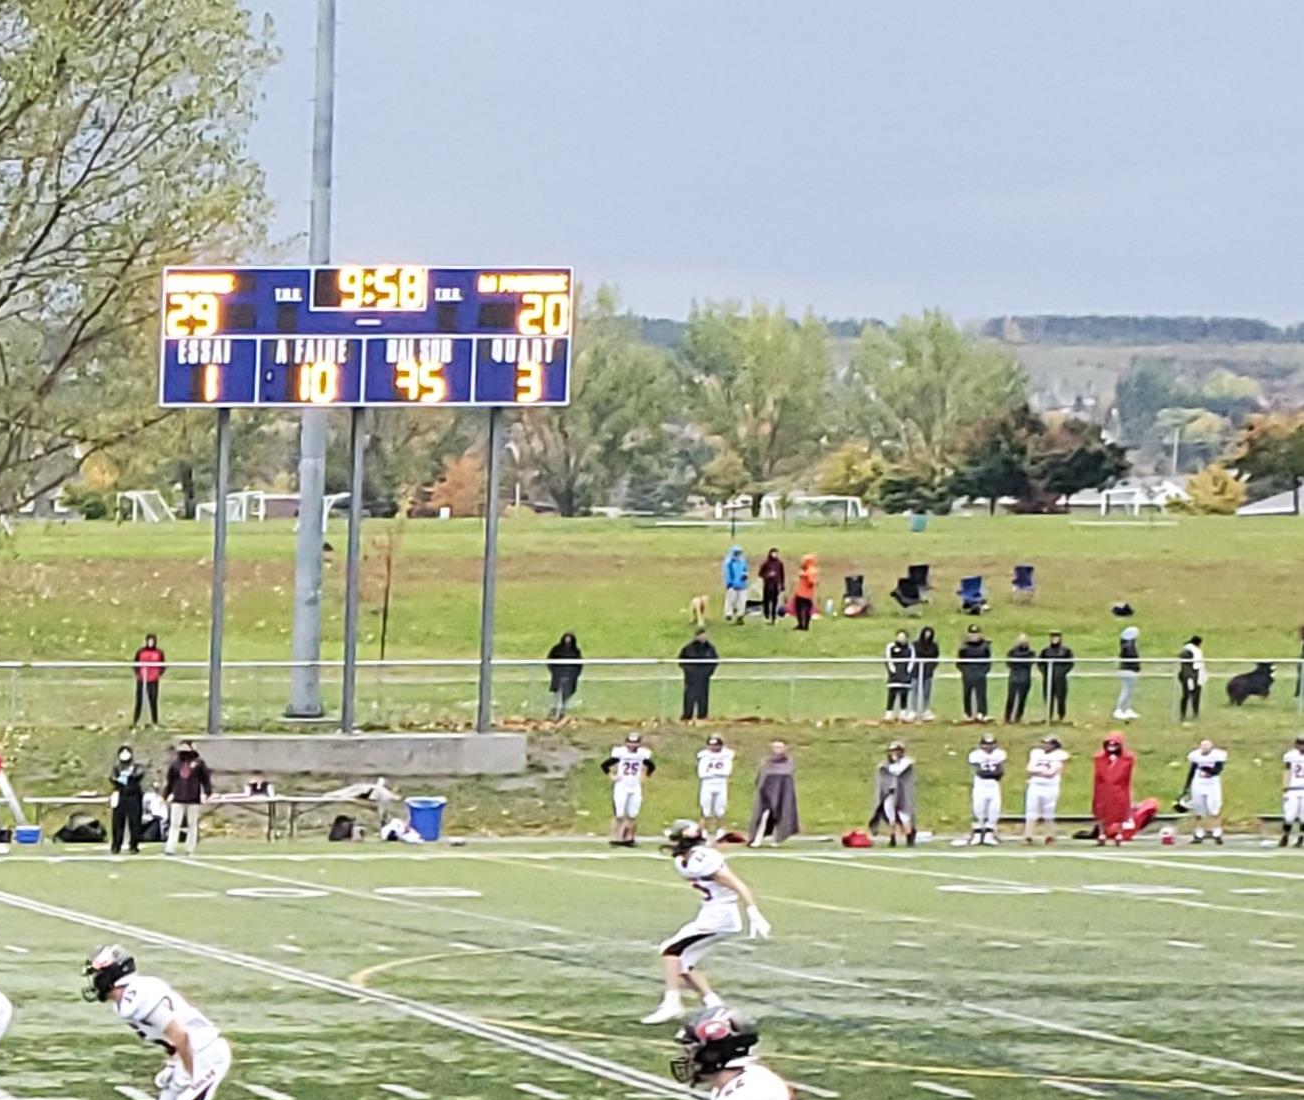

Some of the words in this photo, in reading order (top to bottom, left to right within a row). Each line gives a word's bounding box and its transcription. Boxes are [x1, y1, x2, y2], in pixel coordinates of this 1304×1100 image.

[338, 266, 426, 309] 9:58
[166, 293, 218, 335] 29
[518, 293, 568, 335] 20
[177, 339, 231, 364] ESSAI
[490, 338, 553, 363] QUART
[204, 364, 220, 402] 1
[300, 362, 338, 404] 10
[516, 362, 544, 403] 3
